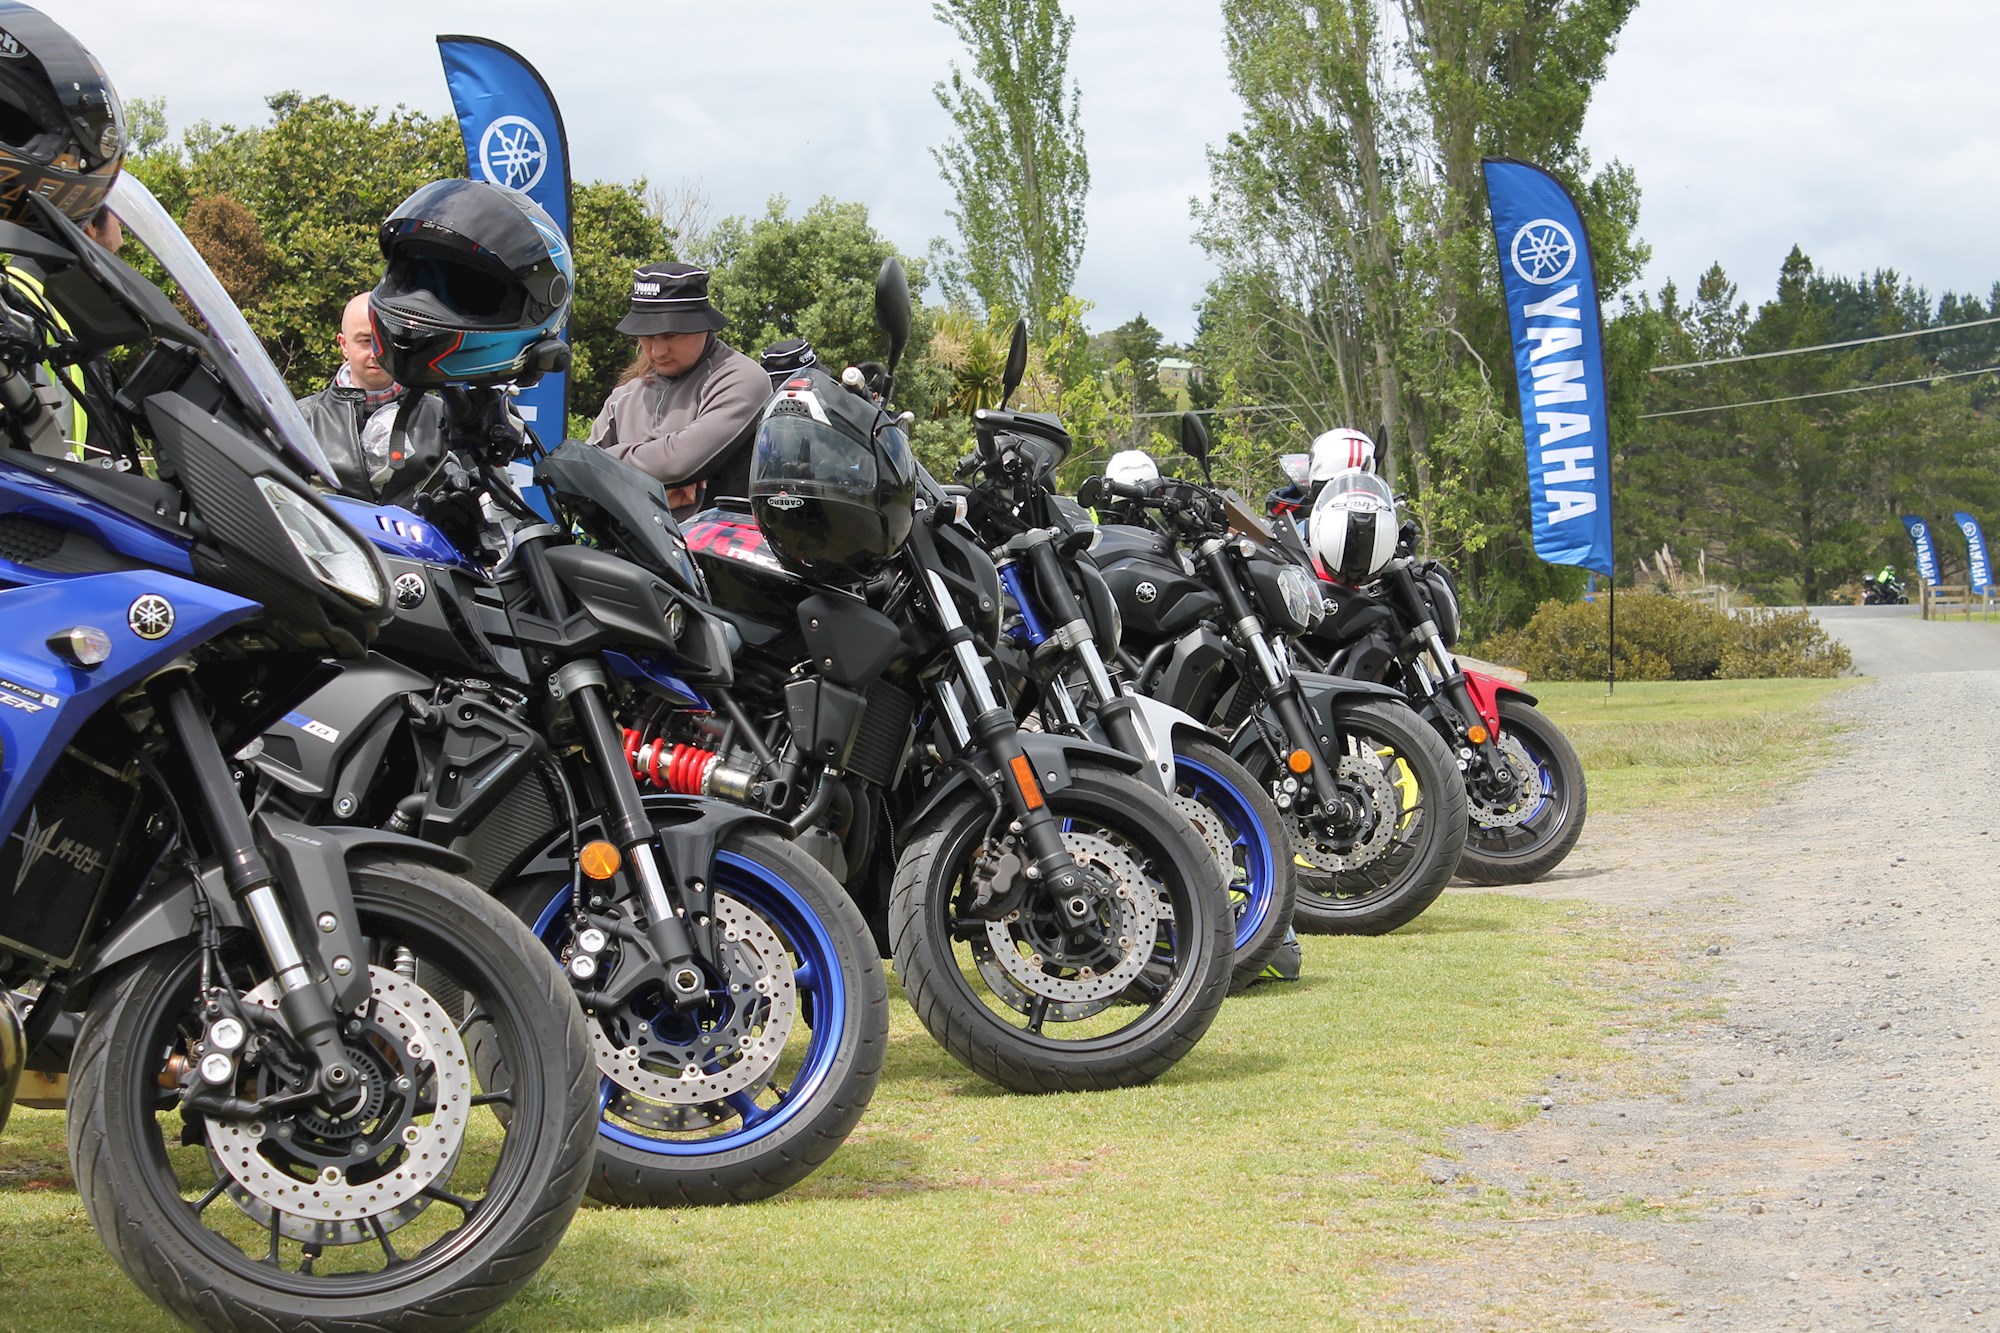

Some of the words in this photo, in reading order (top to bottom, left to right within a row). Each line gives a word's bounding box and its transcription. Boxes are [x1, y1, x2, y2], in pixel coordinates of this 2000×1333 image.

[636, 281, 661, 294] YAMAHA
[1523, 284, 1597, 525] YAMAHA
[1916, 536, 1936, 586] YAMAHA
[1968, 535, 1987, 587] YAMAHA
